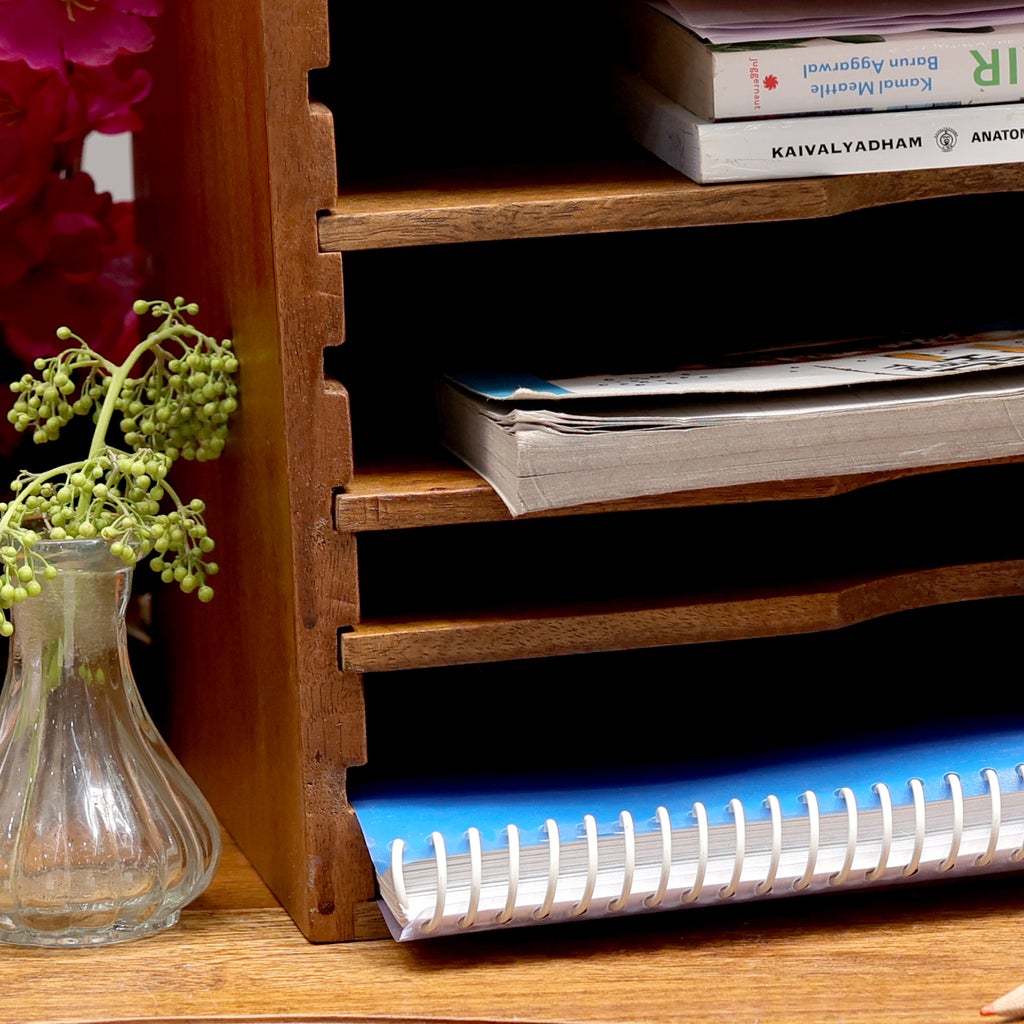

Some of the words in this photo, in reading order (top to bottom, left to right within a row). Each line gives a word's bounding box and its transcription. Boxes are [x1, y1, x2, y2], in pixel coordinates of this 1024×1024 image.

[803, 56, 884, 78] Aggarwal
[889, 56, 939, 70] Barun
[749, 57, 761, 110] juggernaut
[811, 81, 874, 99] Meattle
[878, 77, 932, 94] Kamal
[771, 136, 922, 159] KAIVALYADHAM
